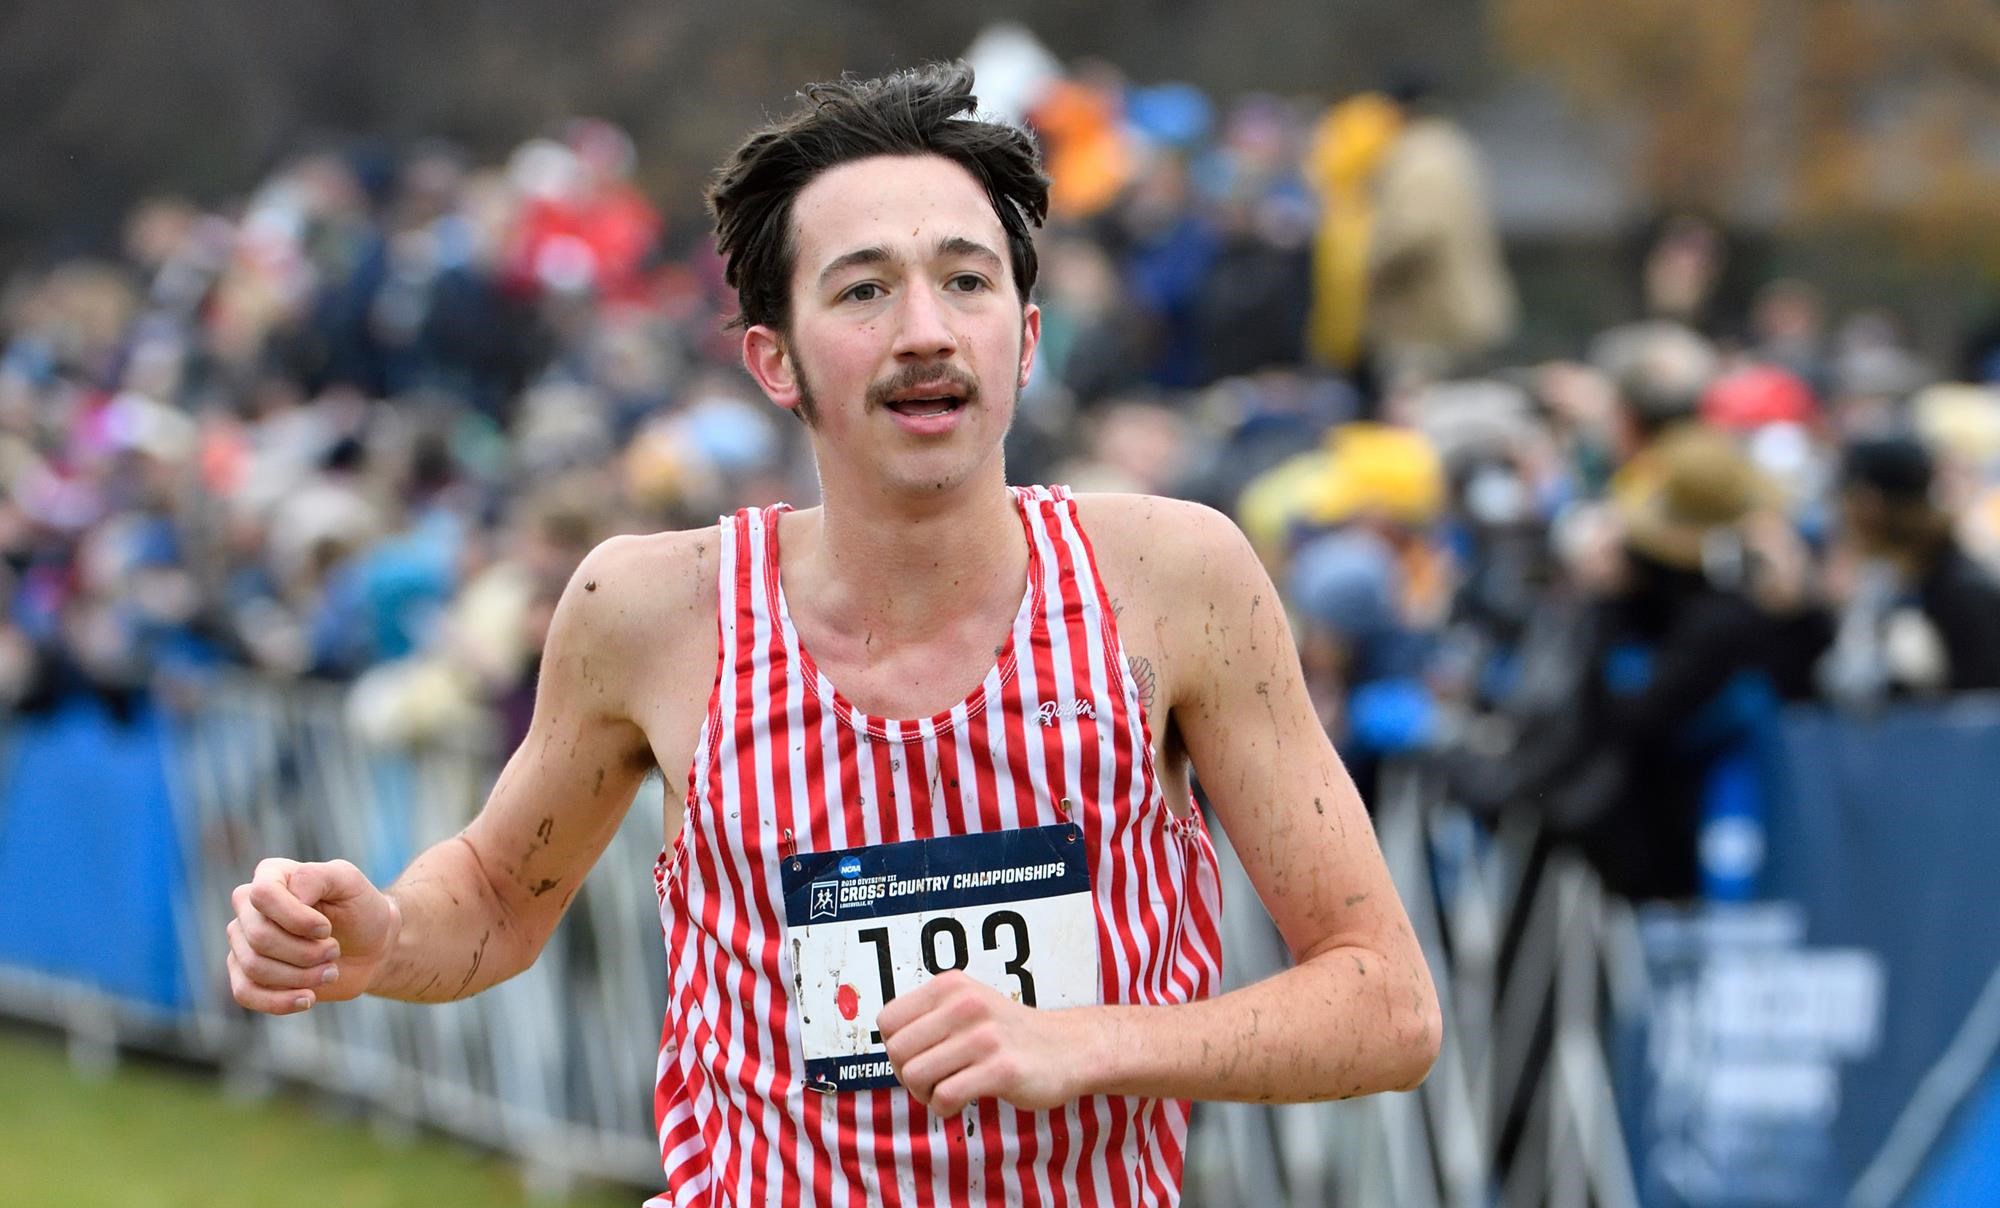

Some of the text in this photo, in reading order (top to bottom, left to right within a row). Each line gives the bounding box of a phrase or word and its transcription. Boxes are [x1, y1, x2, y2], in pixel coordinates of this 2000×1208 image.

[841, 865, 861, 874] NCAA
[840, 862, 1066, 902] CROSS COUNTRY CHAMPIONSHIPS
[857, 876, 887, 885] DIVISION
[839, 1061, 895, 1080] NOVEMB
